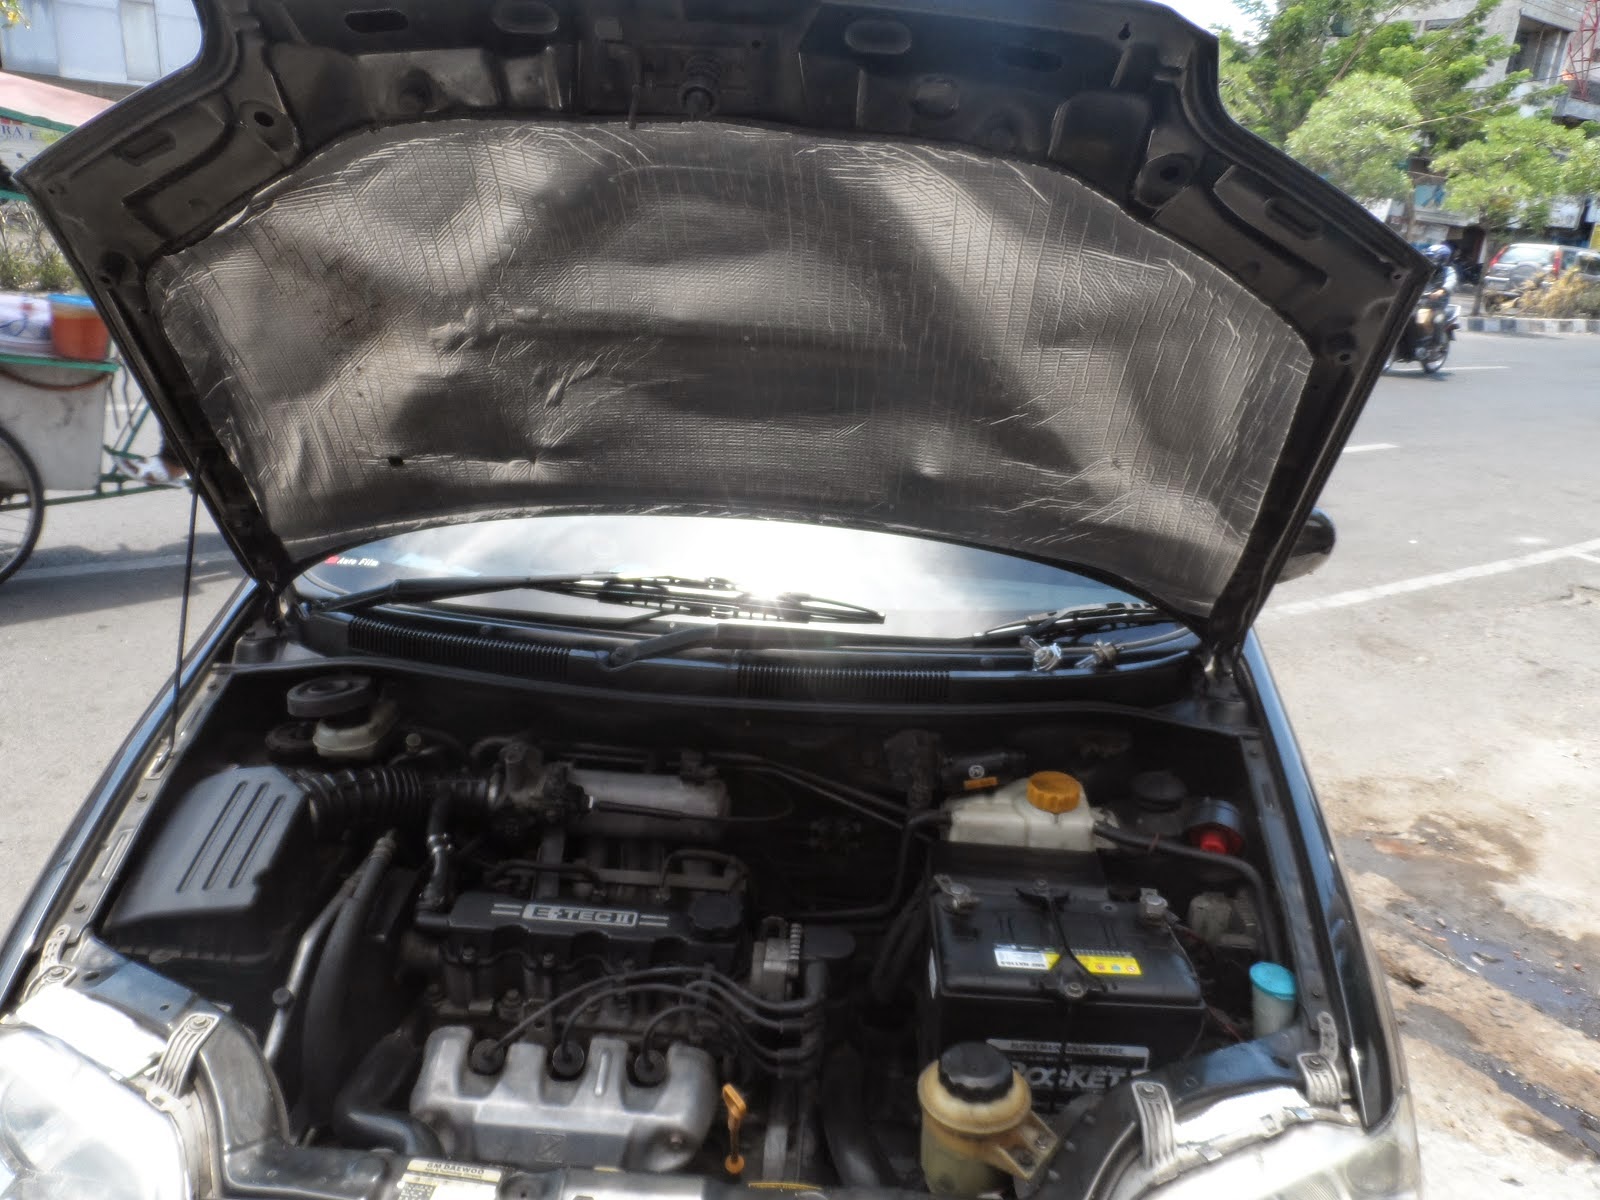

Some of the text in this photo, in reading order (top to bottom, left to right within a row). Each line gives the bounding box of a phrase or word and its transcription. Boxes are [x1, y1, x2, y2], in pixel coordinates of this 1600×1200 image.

[337, 557, 379, 567] Auto Film
[531, 905, 613, 922] E-TEC
[1039, 1043, 1101, 1054] MAINENANCE
[443, 1163, 485, 1175] DAEWOO
